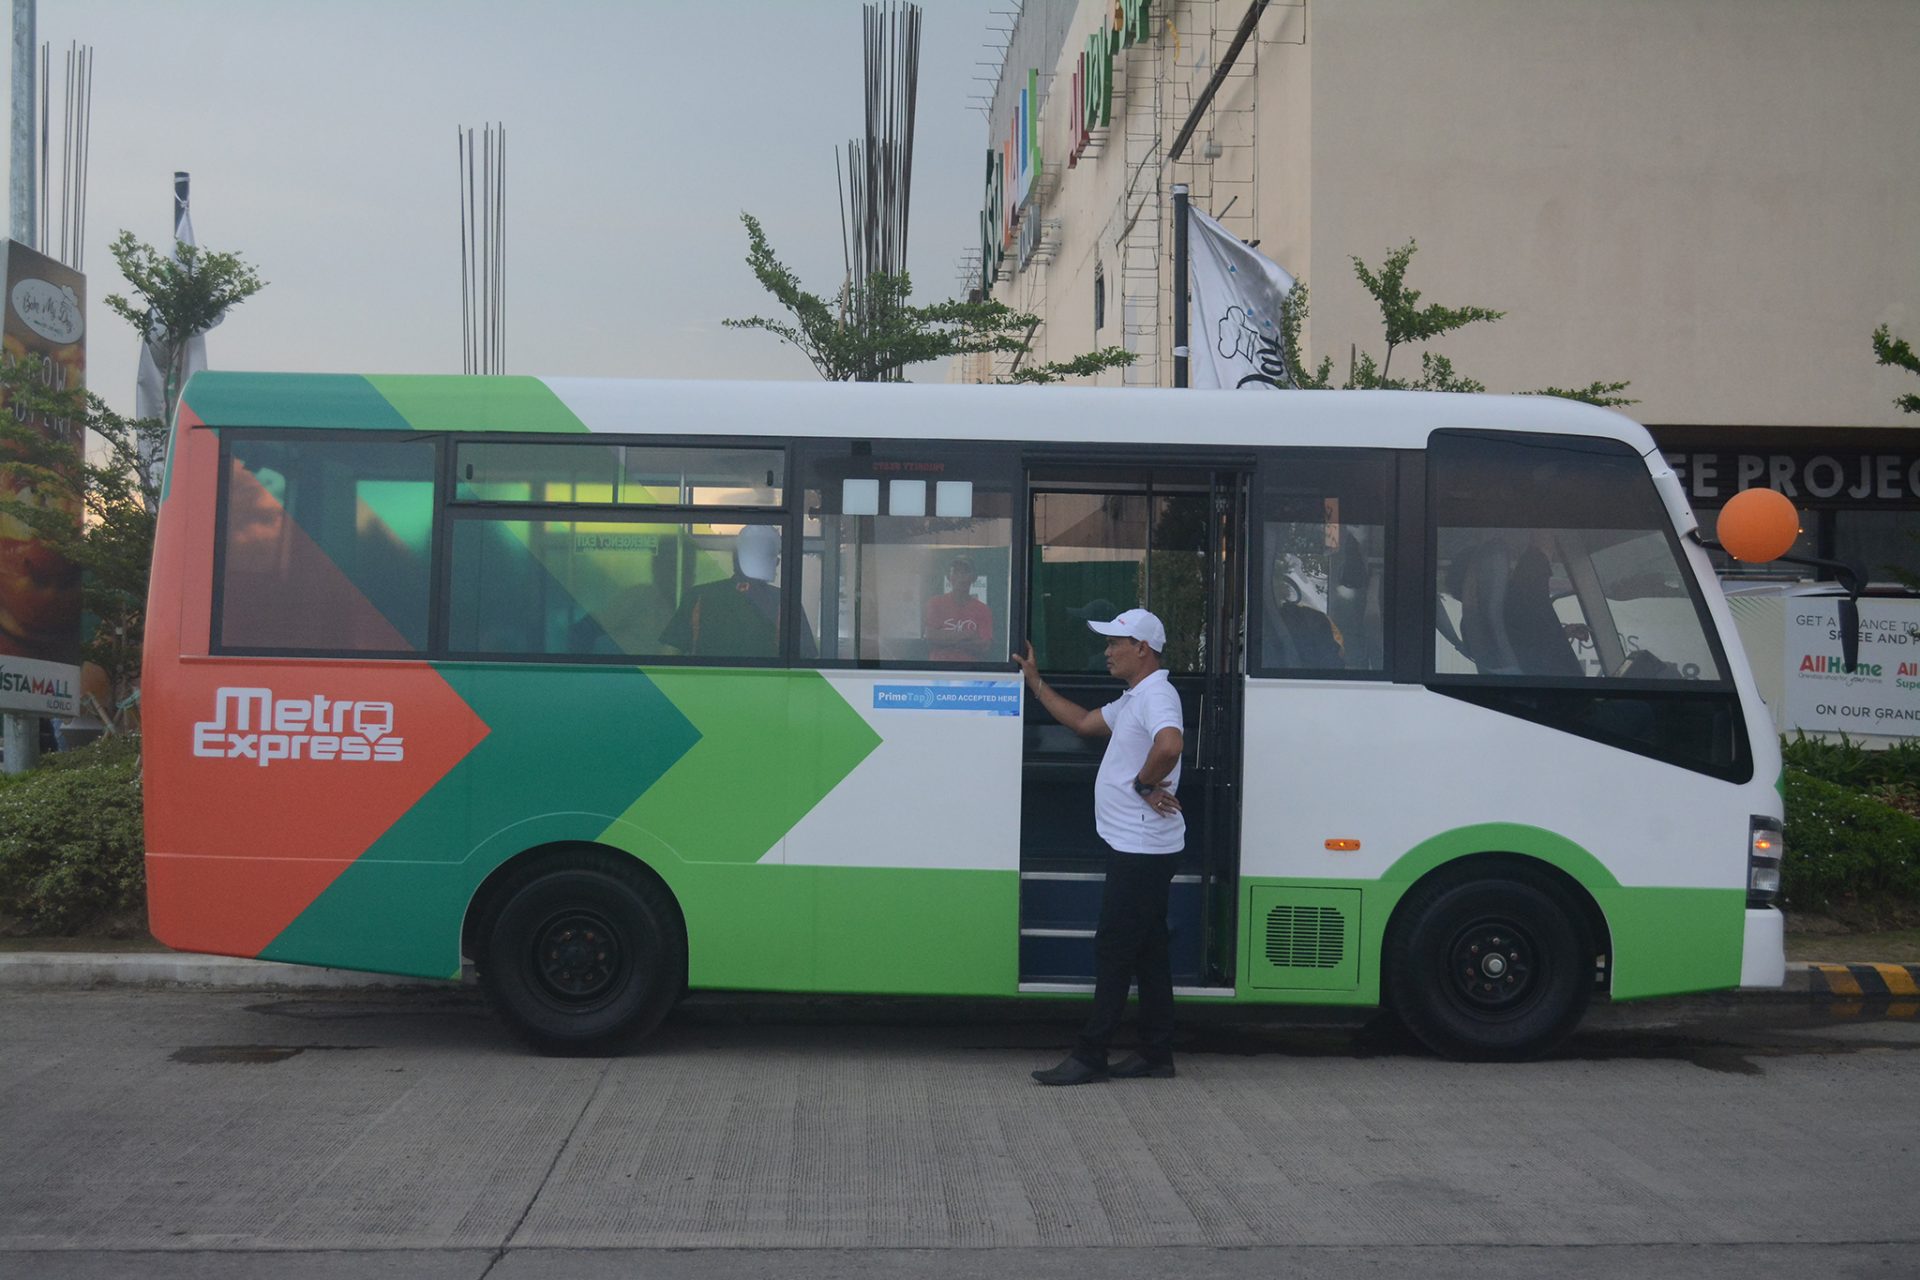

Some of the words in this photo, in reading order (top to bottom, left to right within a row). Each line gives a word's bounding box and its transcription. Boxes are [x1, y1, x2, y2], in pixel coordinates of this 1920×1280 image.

[1796, 615, 1822, 627] GET
[1827, 617, 1837, 627] A
[1877, 633, 1908, 645] AND
[958, 694, 997, 702] ACCEPTED
[216, 687, 393, 733] Metro
[1816, 704, 1837, 715] ON
[1841, 706, 1870, 717] OUR
[193, 722, 404, 767] Express
